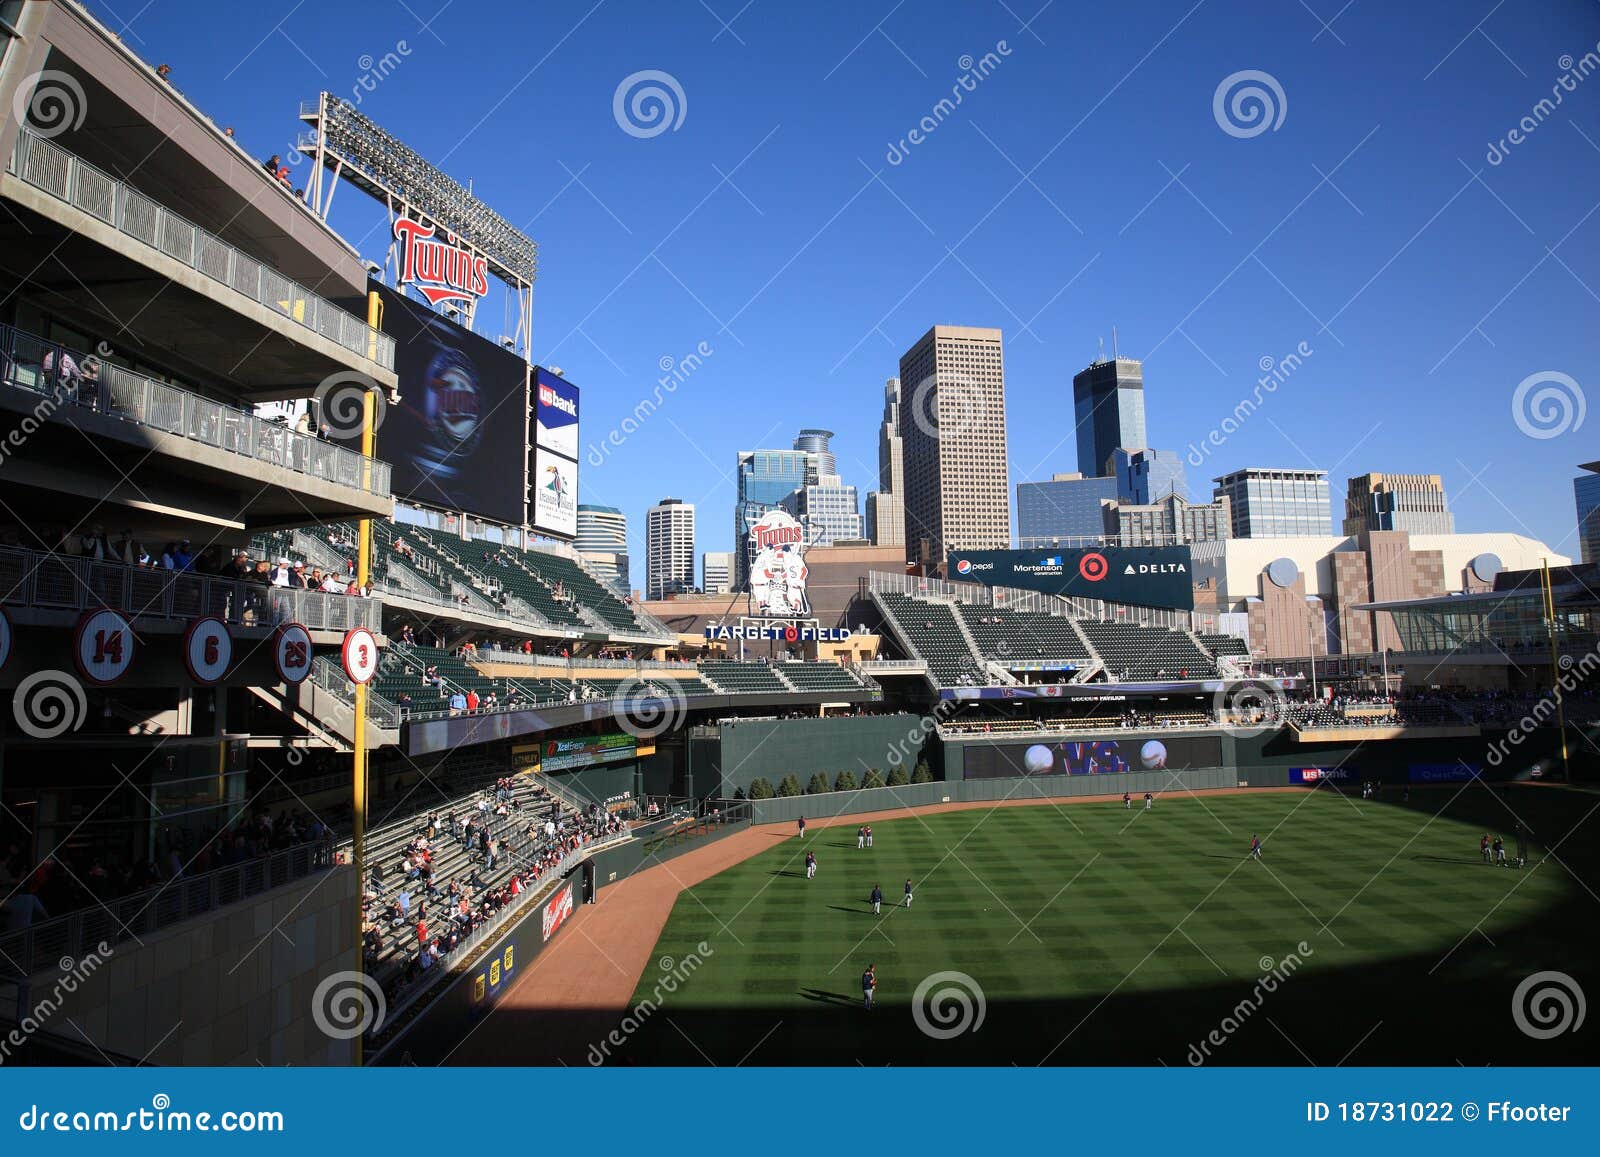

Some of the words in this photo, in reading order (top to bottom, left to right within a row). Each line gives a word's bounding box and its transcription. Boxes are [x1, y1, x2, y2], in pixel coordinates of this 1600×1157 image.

[393, 217, 488, 303] Twins
[751, 522, 802, 550] Twins
[972, 562, 994, 571] pepsi
[1014, 564, 1062, 572] Mortenson
[1139, 563, 1186, 574] DELTA
[706, 625, 782, 640] TARGET
[801, 627, 852, 641] FIELD
[93, 630, 122, 664] 14
[204, 635, 218, 665] 6
[358, 644, 368, 668] 3
